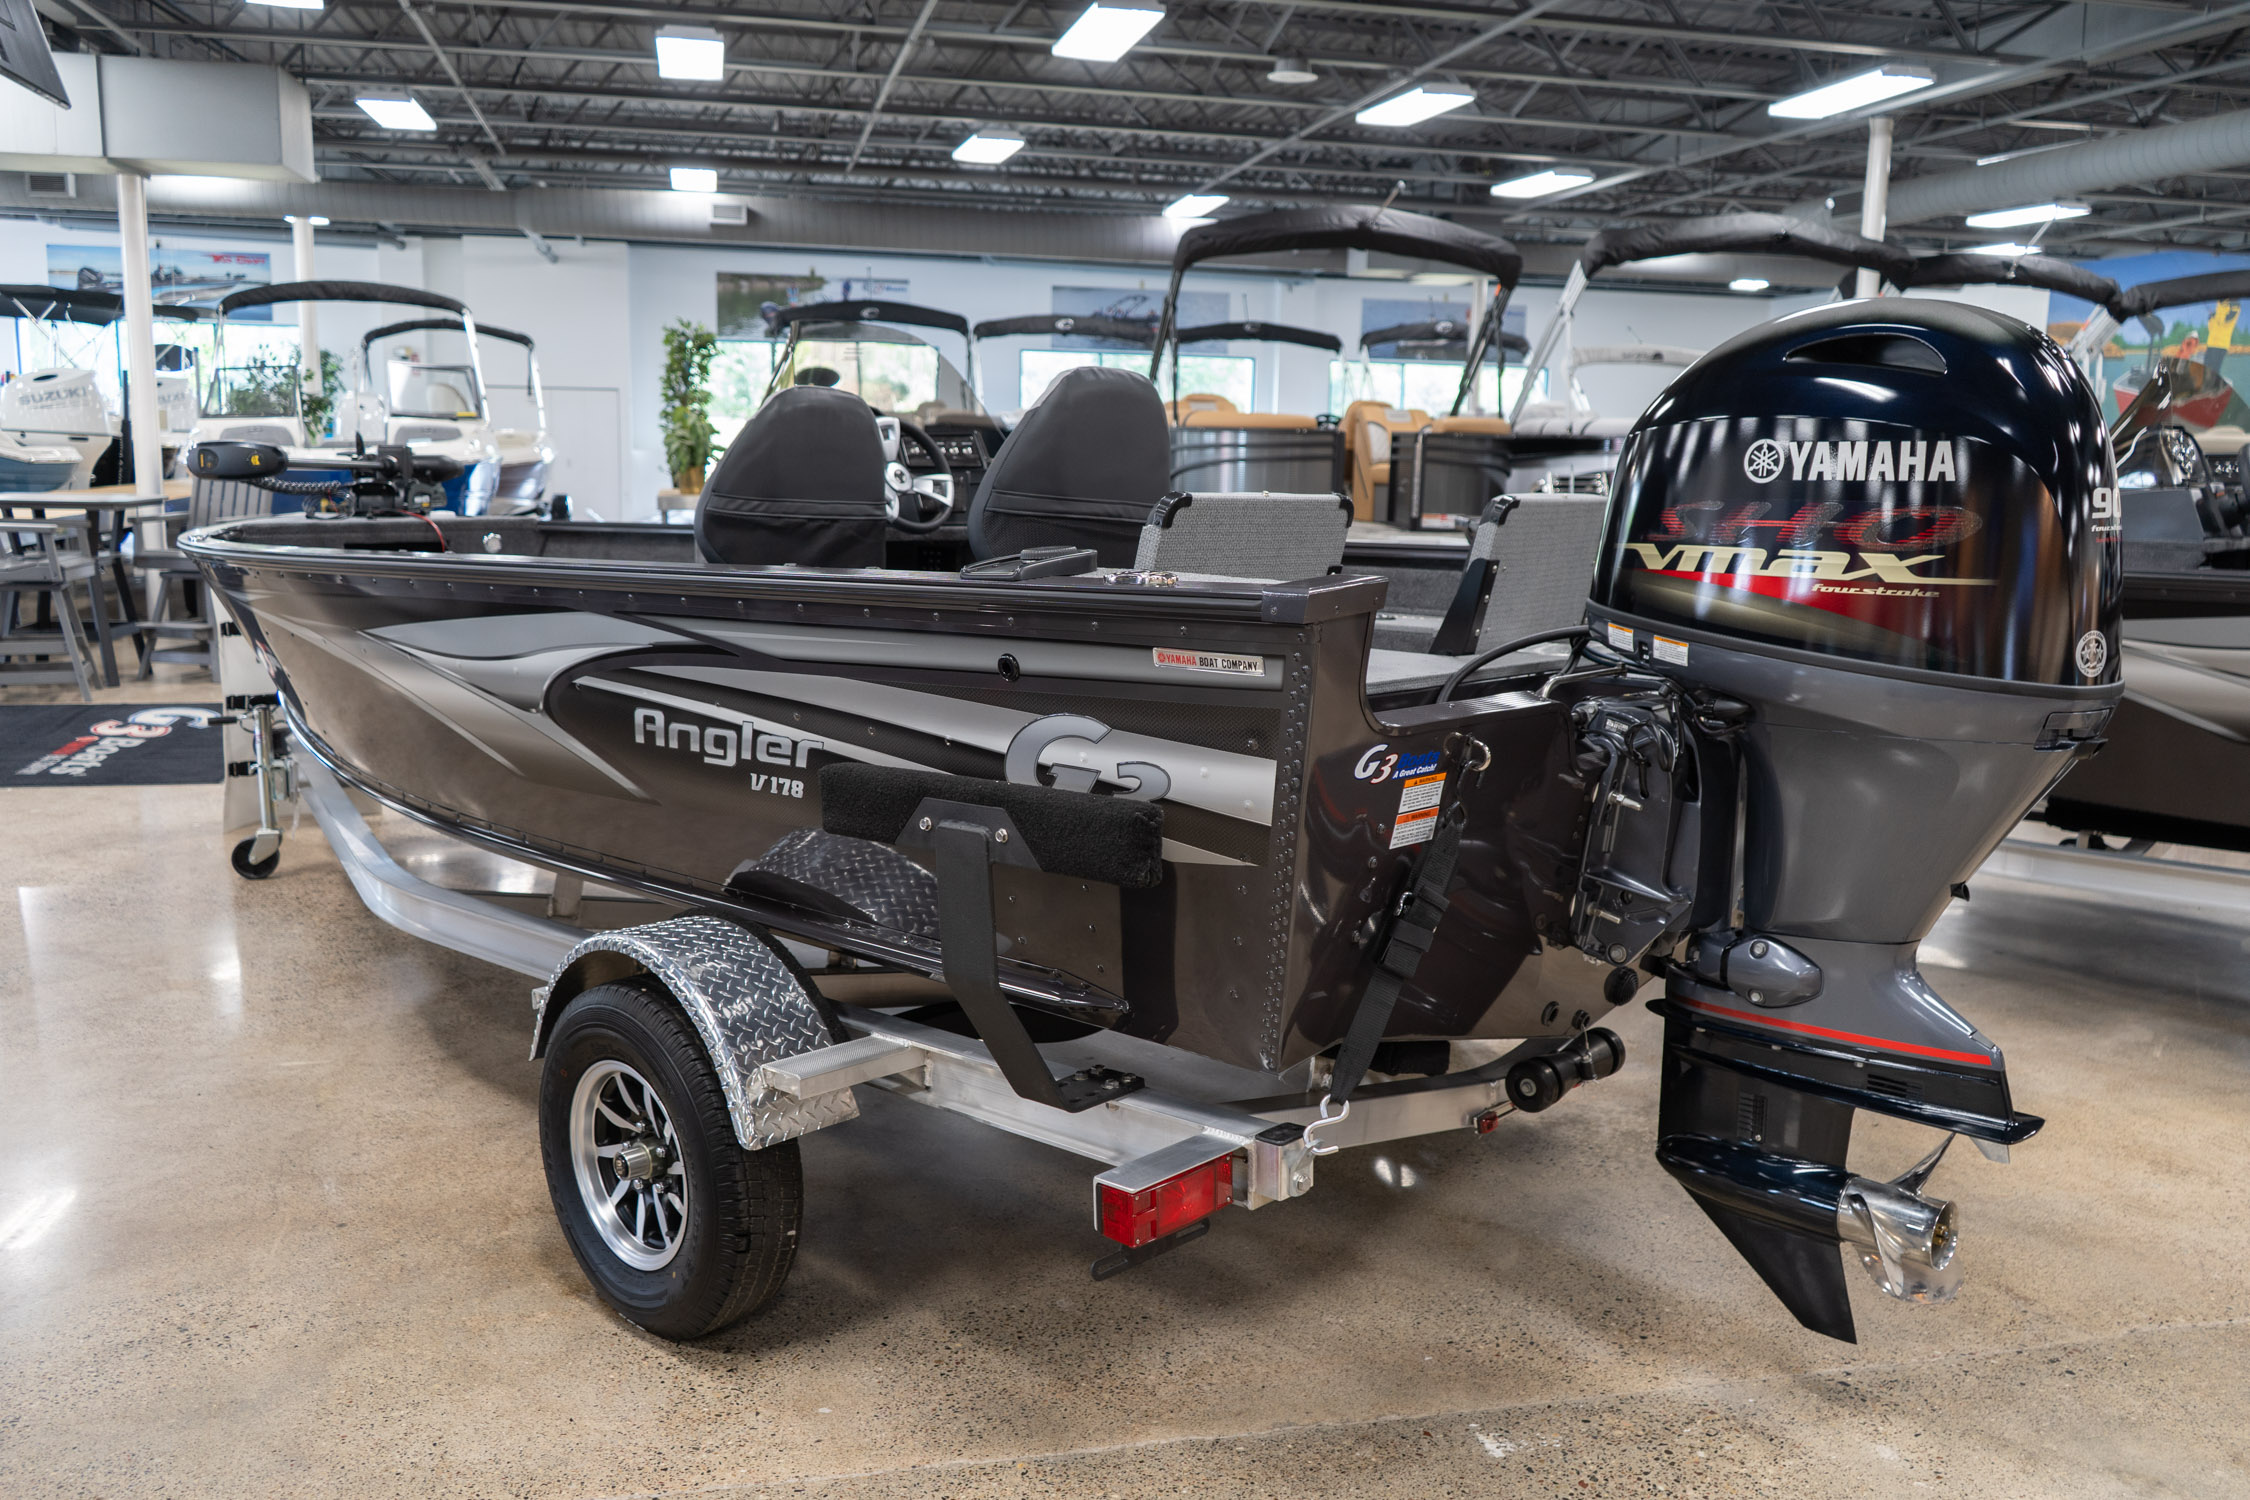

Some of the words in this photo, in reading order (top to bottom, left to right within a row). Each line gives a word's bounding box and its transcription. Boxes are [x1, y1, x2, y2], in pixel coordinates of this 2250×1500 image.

[1789, 440, 1957, 482] YAMAHA
[1646, 500, 1984, 551] SHO
[1812, 583, 1940, 598] fourstroke
[1166, 653, 1197, 666] YAMAHA
[1199, 656, 1218, 668] BOAT
[1221, 658, 1258, 671] COMPANY
[49, 736, 146, 777] Boats
[634, 706, 824, 768] Angler
[1354, 743, 1399, 784] G3
[1396, 751, 1441, 769] Boats
[1393, 771, 1399, 779] A
[1399, 767, 1416, 778] Great
[1416, 763, 1438, 775] Catch!
